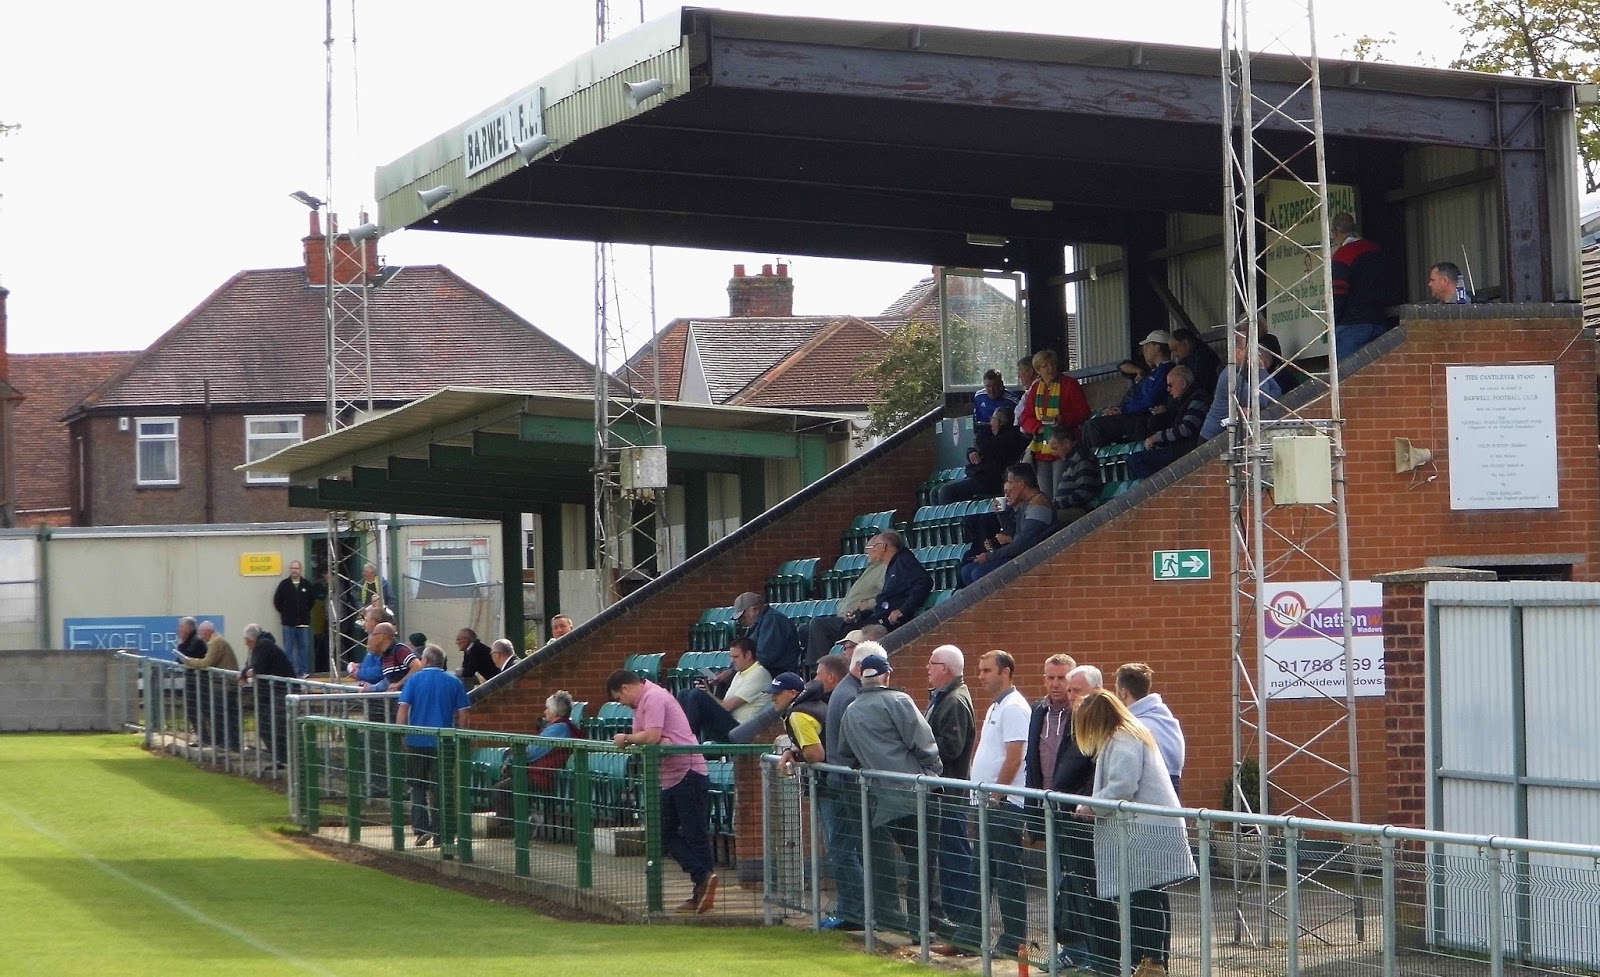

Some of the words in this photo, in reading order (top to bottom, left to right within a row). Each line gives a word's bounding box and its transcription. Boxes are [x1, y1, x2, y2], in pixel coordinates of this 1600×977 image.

[468, 111, 515, 170] BARWEL
[1279, 197, 1315, 230] EXPRESS
[1277, 602, 1299, 618] NW
[1278, 659, 1333, 673] 01788
[1339, 658, 1371, 671] 569
